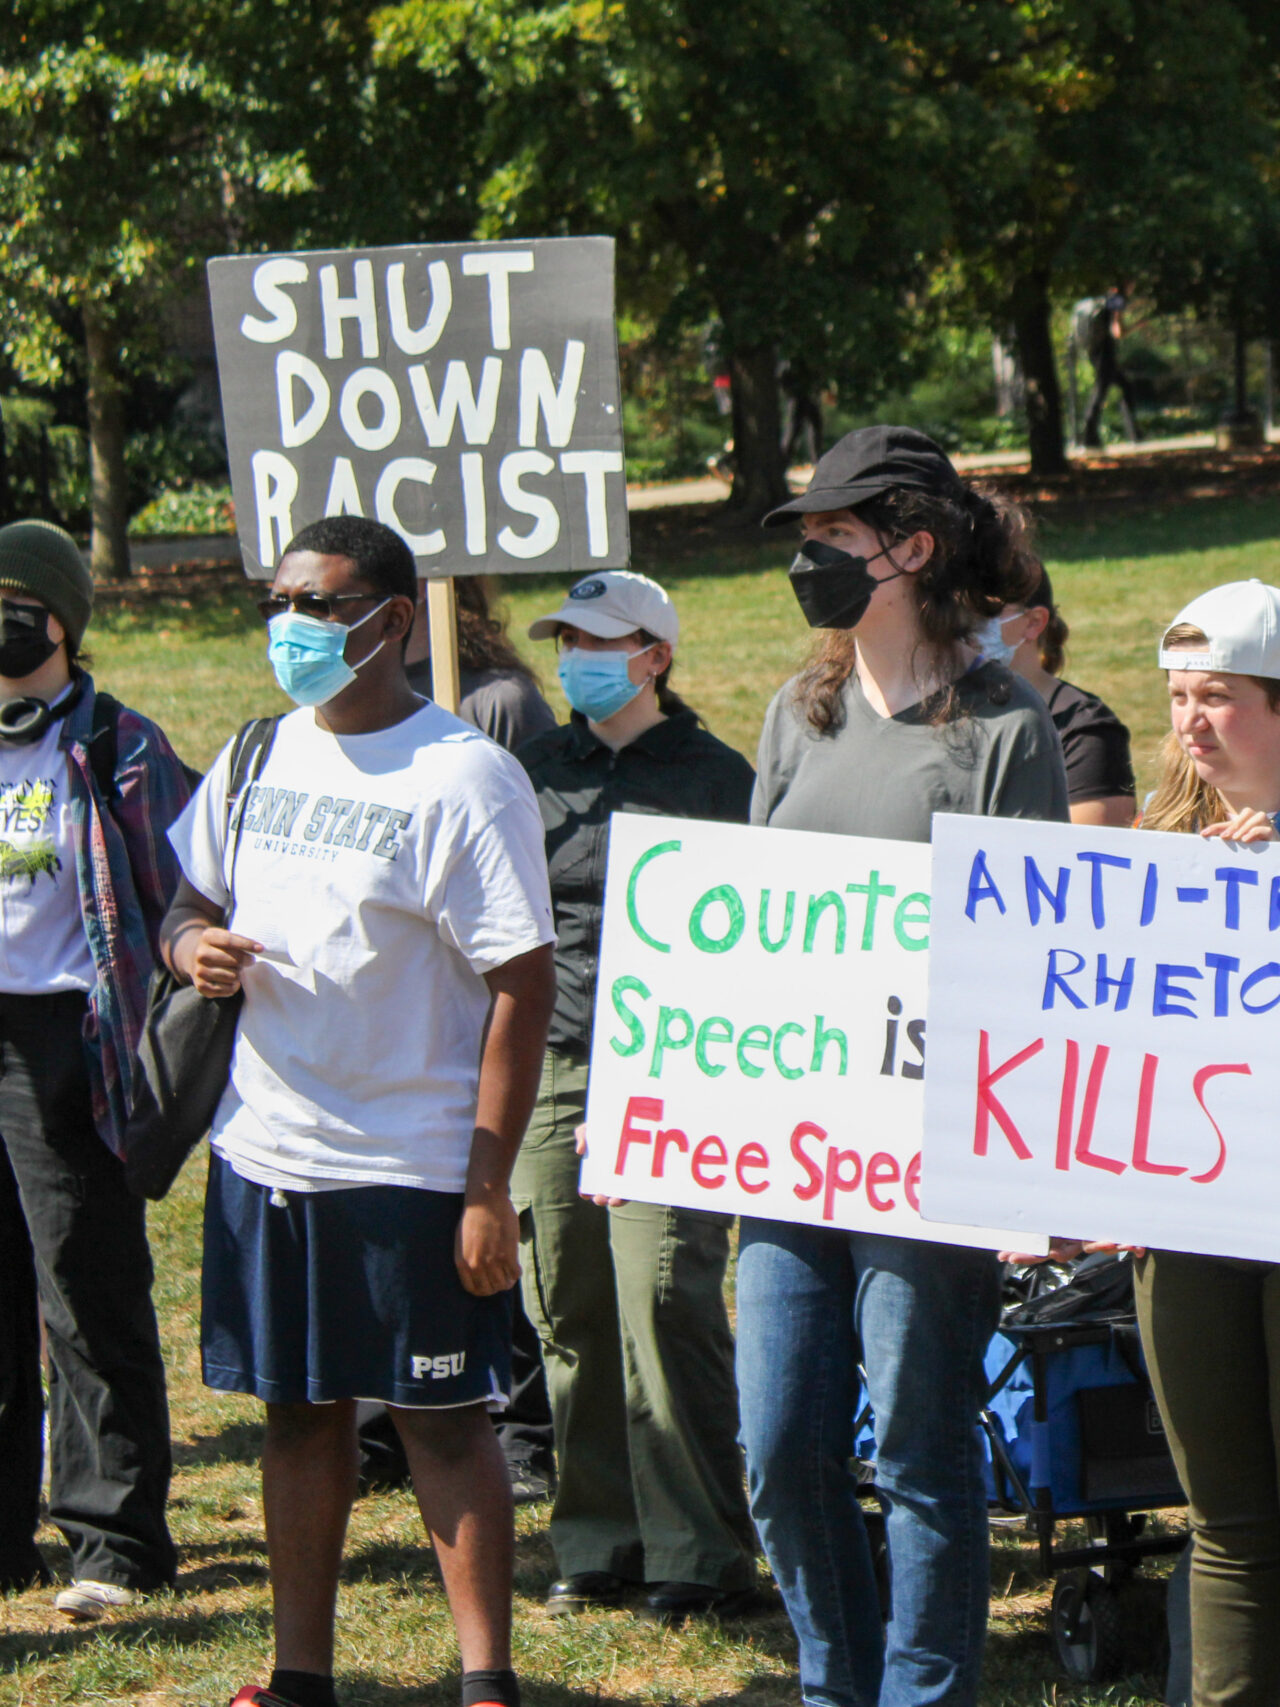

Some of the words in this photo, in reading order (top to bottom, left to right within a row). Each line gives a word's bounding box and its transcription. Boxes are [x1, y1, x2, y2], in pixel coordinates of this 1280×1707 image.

[241, 250, 535, 359] SHUT
[276, 339, 585, 450] DOWN
[252, 449, 623, 567] RACIST
[232, 786, 309, 839] ENN
[303, 795, 413, 862] STATE
[254, 837, 340, 863] UNIVERSITY
[626, 840, 931, 955] Counte
[609, 975, 849, 1081] Speech
[880, 995, 927, 1081] is
[614, 1096, 770, 1194] Free
[973, 1029, 1252, 1184] KILLS
[410, 1351, 466, 1380] PSU
